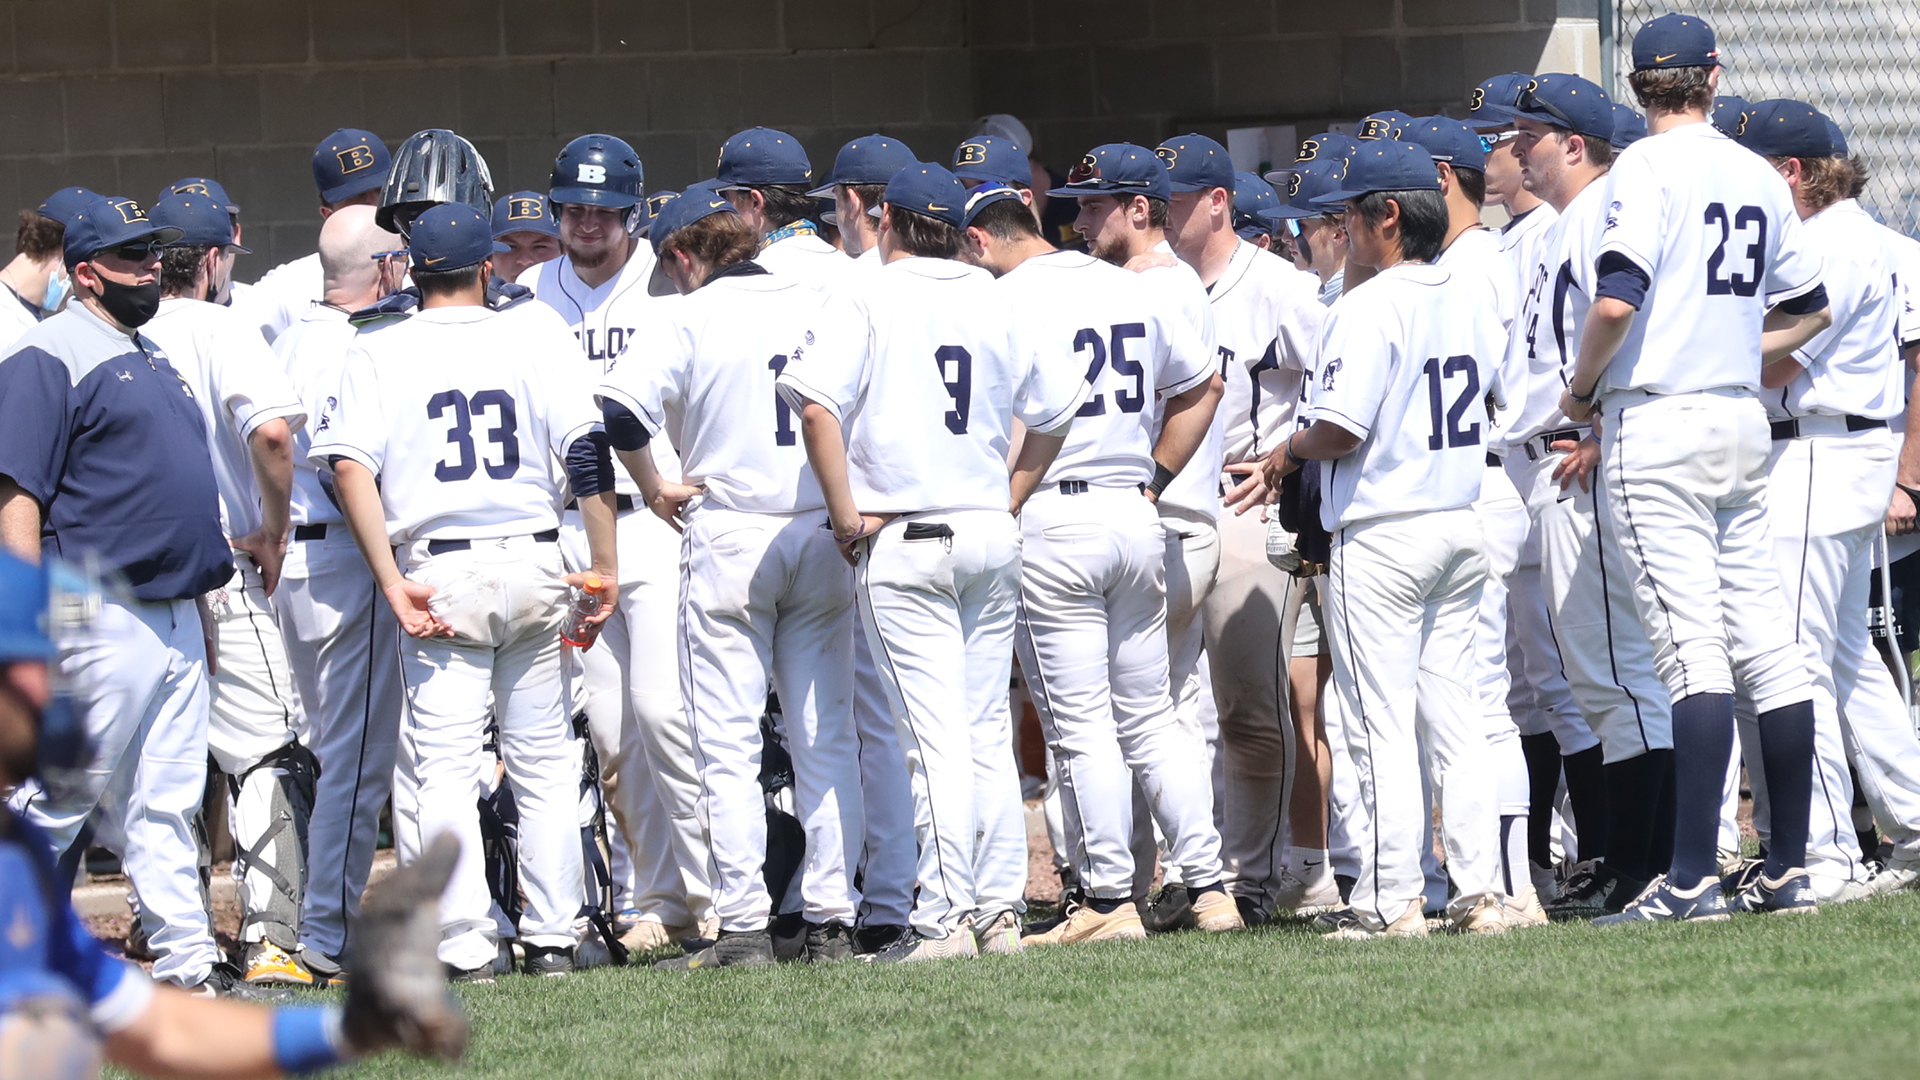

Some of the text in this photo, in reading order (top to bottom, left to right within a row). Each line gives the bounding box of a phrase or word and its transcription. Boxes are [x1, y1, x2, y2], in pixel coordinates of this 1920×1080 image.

[1358, 118, 1390, 140] B
[336, 144, 375, 175] B
[955, 143, 987, 167] B
[1293, 140, 1320, 163] B
[576, 163, 607, 184] B
[114, 200, 149, 224] B
[508, 197, 543, 220] B
[1704, 202, 1768, 297] 23
[1073, 322, 1145, 416] 25
[934, 345, 972, 434] 9
[1423, 354, 1481, 450] 12
[427, 389, 519, 482] 33
